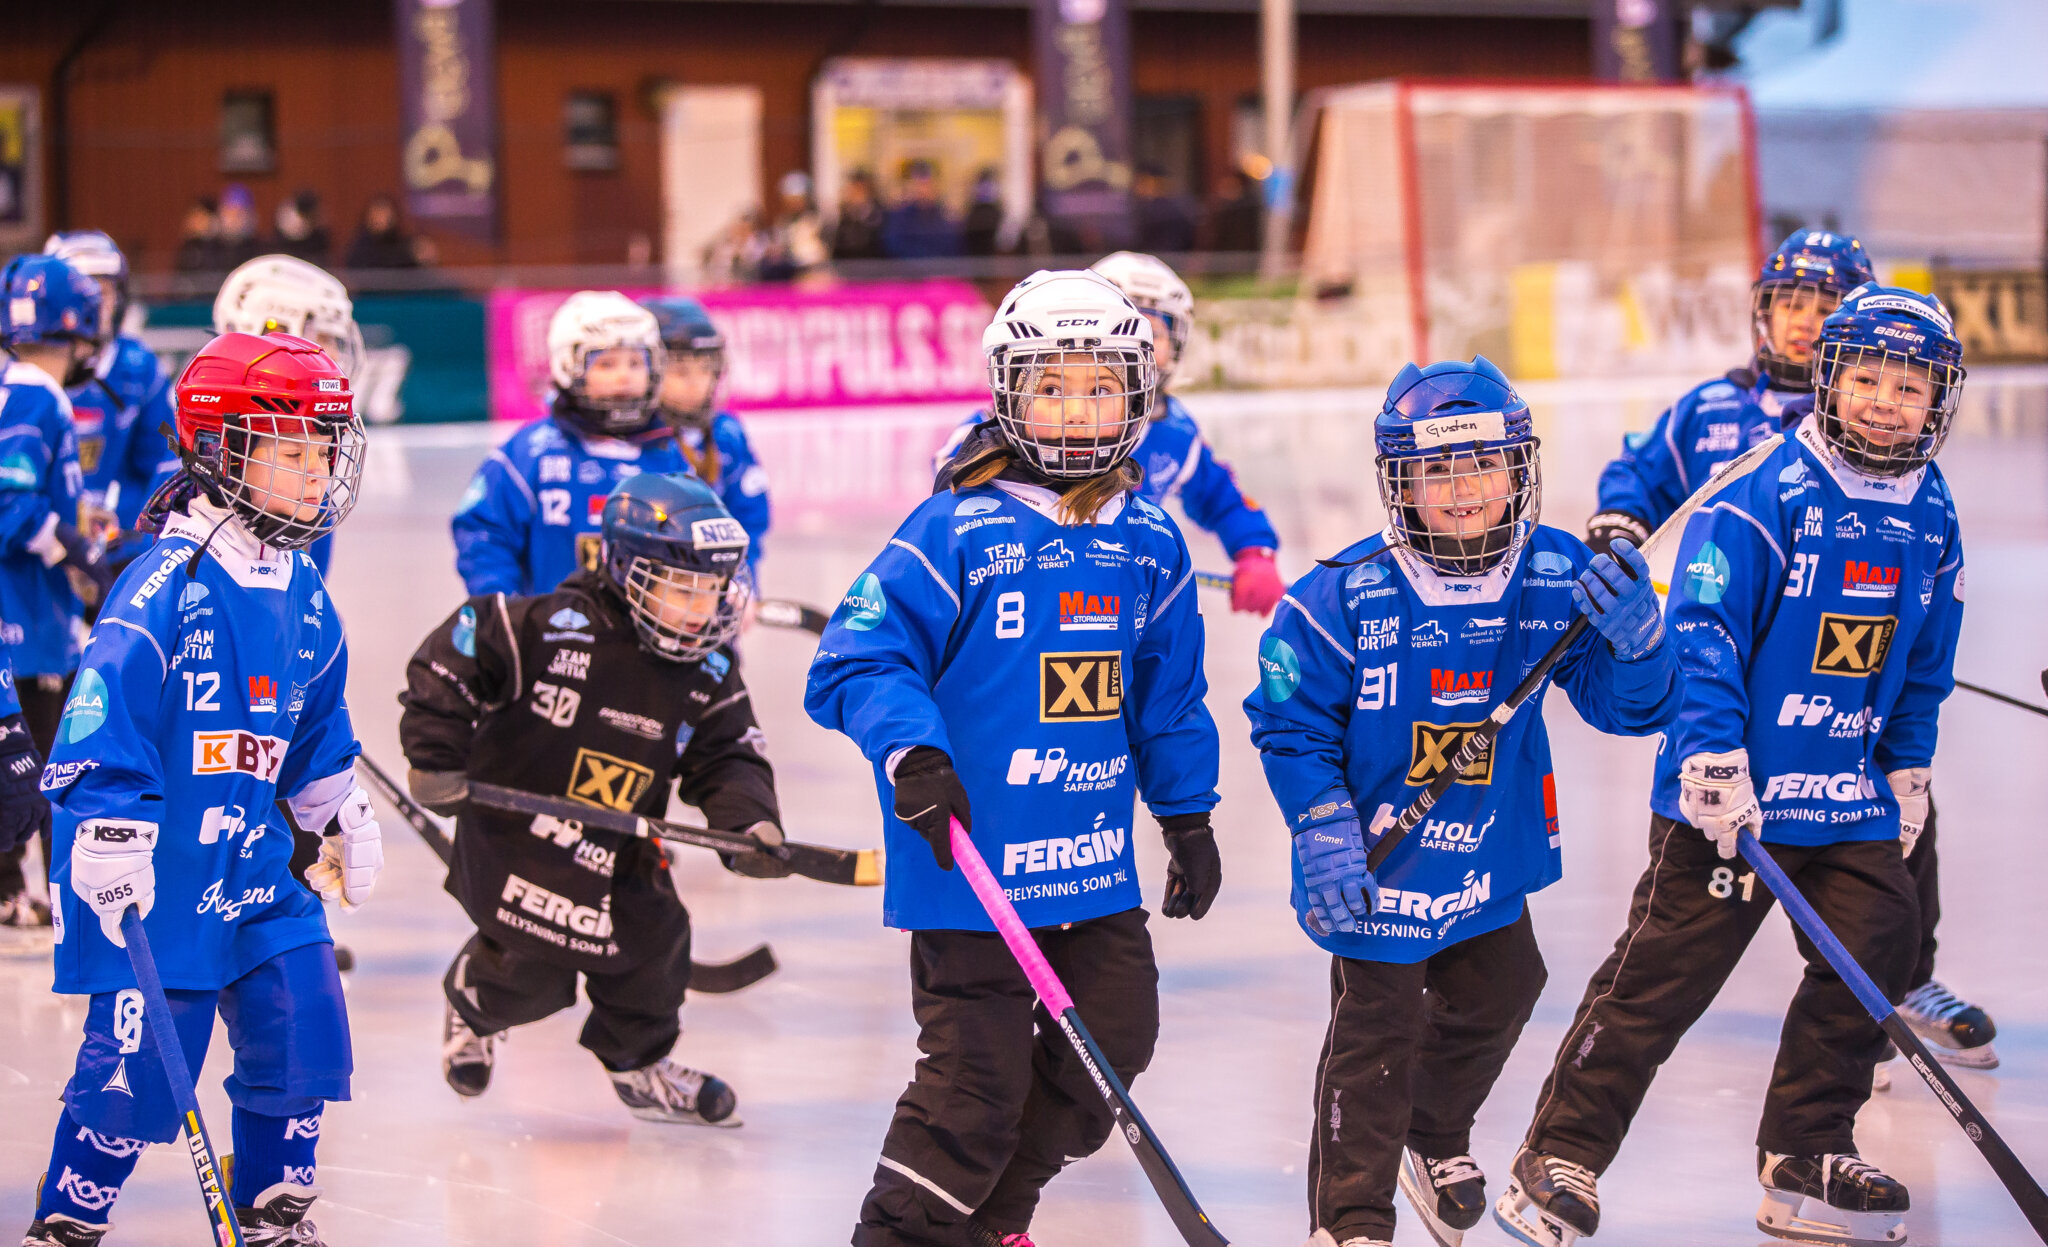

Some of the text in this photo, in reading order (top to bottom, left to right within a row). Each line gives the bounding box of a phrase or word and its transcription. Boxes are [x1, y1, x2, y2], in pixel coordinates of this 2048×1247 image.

[1804, 232, 1833, 248] 21
[1056, 319, 1100, 328] CCM
[1872, 325, 1927, 344] BAUER
[321, 381, 340, 390] TOWE
[191, 394, 221, 403] CCM
[313, 402, 349, 412] CCM
[1425, 419, 1478, 438] Gusten
[194, 462, 212, 475] CCM
[954, 516, 1016, 536] Motala kommun
[984, 542, 1026, 562] TEAM
[1037, 553, 1061, 562] VILLA
[968, 558, 1025, 586] SPORTIA
[1037, 560, 1070, 570] VERKET
[1844, 560, 1901, 585] MAXI
[843, 595, 881, 613] MOTALA
[1059, 591, 1121, 616] MAXI
[995, 591, 1025, 640] 8
[1073, 615, 1119, 624] STORMARKNAD
[1360, 616, 1400, 635] TEAM
[1519, 620, 1549, 631] KAFA
[1411, 634, 1434, 642] VILLA
[1411, 640, 1443, 649] VERKET
[1047, 660, 1121, 713] XL BYGG
[1356, 661, 1399, 711] 91
[1430, 668, 1494, 693] MAXI
[182, 671, 220, 711] 12
[1441, 688, 1492, 700] STORMARKNAD
[531, 679, 581, 728] 30
[1828, 728, 1859, 739] SAFER
[1066, 754, 1128, 782] HOLMS
[1704, 764, 1739, 780] KOSA
[575, 757, 637, 813] XL
[1063, 782, 1094, 793] SAFER
[1310, 801, 1339, 820] KOSA
[1728, 803, 1758, 830] 3033
[1830, 811, 1862, 824] SOM
[93, 825, 138, 843] KOSA
[1314, 832, 1345, 846] Comet
[1420, 837, 1455, 851] SAFER
[1004, 880, 1079, 902] BELYSNING
[1083, 875, 1112, 893] SOM
[1707, 866, 1756, 902] 81
[97, 883, 133, 906] 5055
[496, 906, 567, 945] BELYSNING
[1911, 1053, 1963, 1117] BRISSE
[187, 1130, 223, 1212] DELTA
